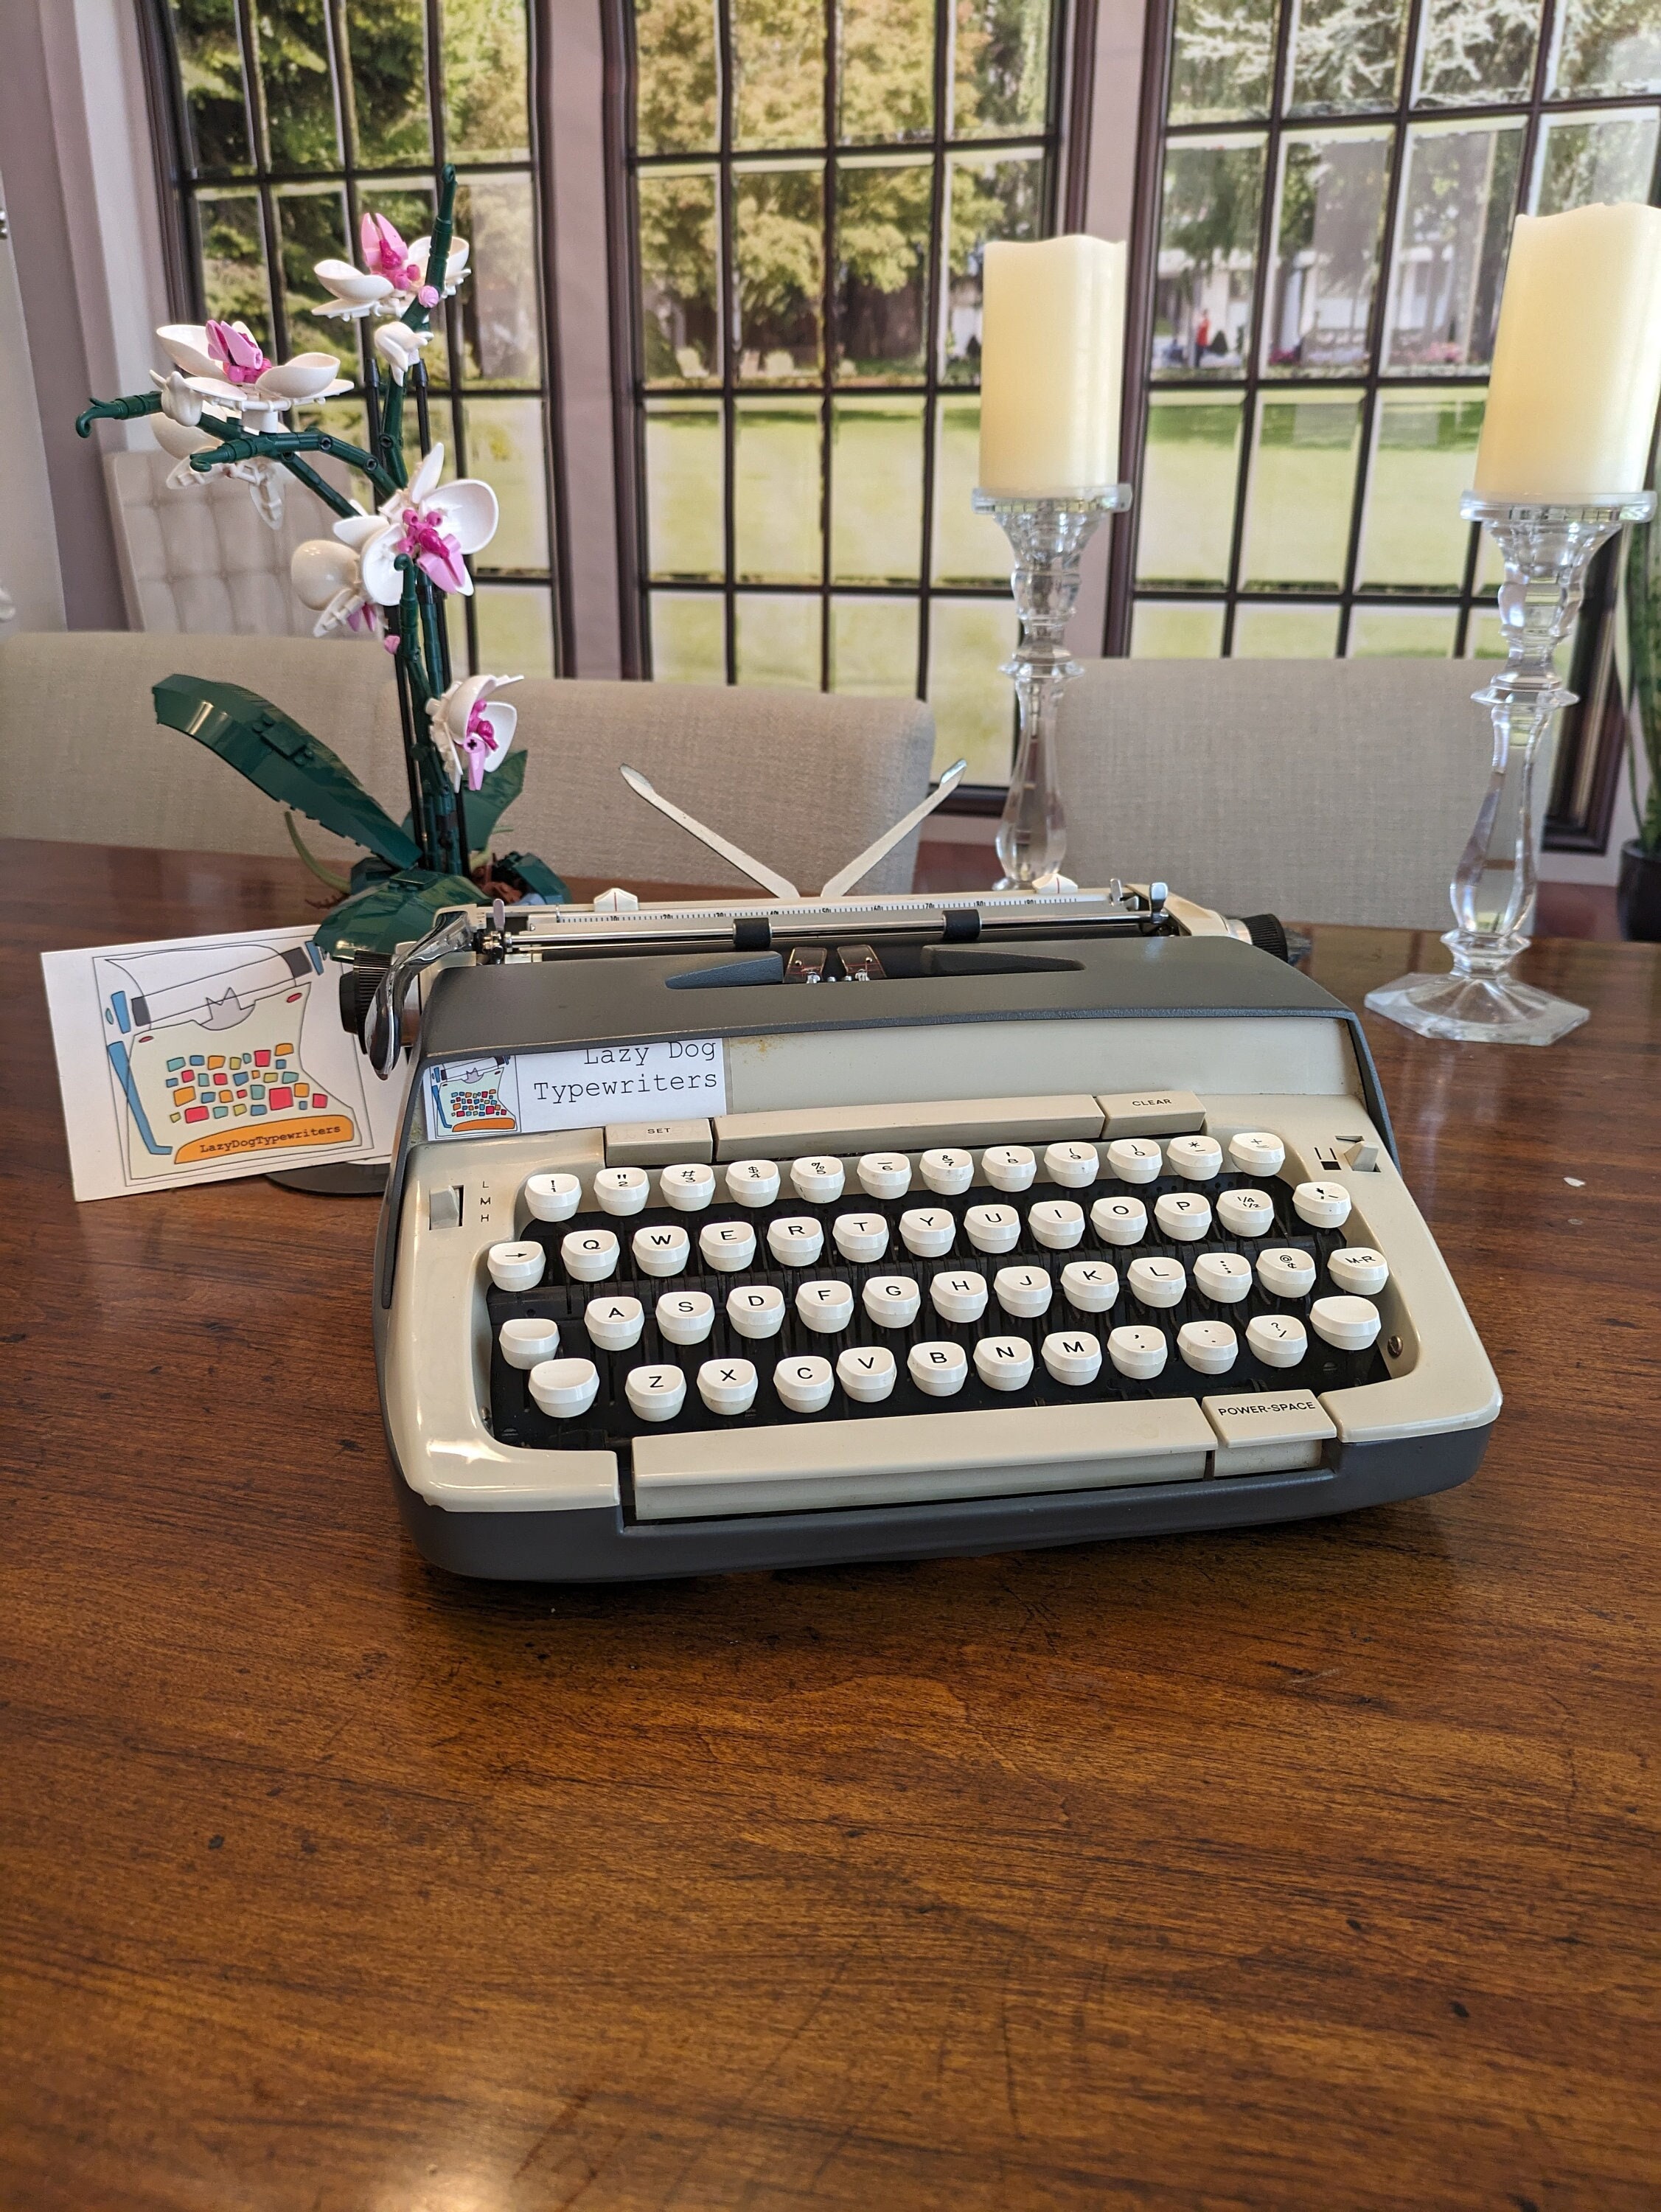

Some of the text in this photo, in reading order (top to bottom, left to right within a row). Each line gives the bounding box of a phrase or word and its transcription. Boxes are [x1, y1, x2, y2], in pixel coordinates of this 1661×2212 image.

[583, 1041, 717, 1066] Lazy Dog
[534, 1074, 717, 1104] Typewriters
[1132, 1099, 1172, 1107] CLEAR
[200, 1126, 341, 1153] LazyDogTypewriters
[482, 1180, 490, 1189] L
[480, 1197, 491, 1206] M
[480, 1214, 490, 1222] H
[583, 1240, 601, 1250] Q
[651, 1235, 671, 1245] W
[721, 1231, 737, 1240] E
[788, 1226, 805, 1235] R
[853, 1222, 868, 1231] T
[919, 1217, 933, 1226] Y
[985, 1213, 1002, 1222] U
[1054, 1210, 1062, 1218] I
[1112, 1206, 1129, 1214] O
[1177, 1202, 1190, 1210] P
[609, 1307, 624, 1318] A
[678, 1302, 694, 1312] S
[748, 1296, 764, 1306] D
[818, 1290, 831, 1301] F
[886, 1286, 901, 1295] G
[952, 1281, 969, 1290] H
[1020, 1276, 1031, 1285] J
[1083, 1270, 1101, 1280] K
[1149, 1267, 1169, 1276] L
[1345, 1255, 1376, 1265] M-R
[649, 1376, 664, 1388] Z
[720, 1369, 737, 1381] X
[798, 1368, 812, 1379] C
[857, 1357, 874, 1368] V
[930, 1352, 947, 1363] B
[996, 1347, 1014, 1357] N
[1062, 1341, 1084, 1352] M
[1218, 1401, 1315, 1416] POWER-SPACE
